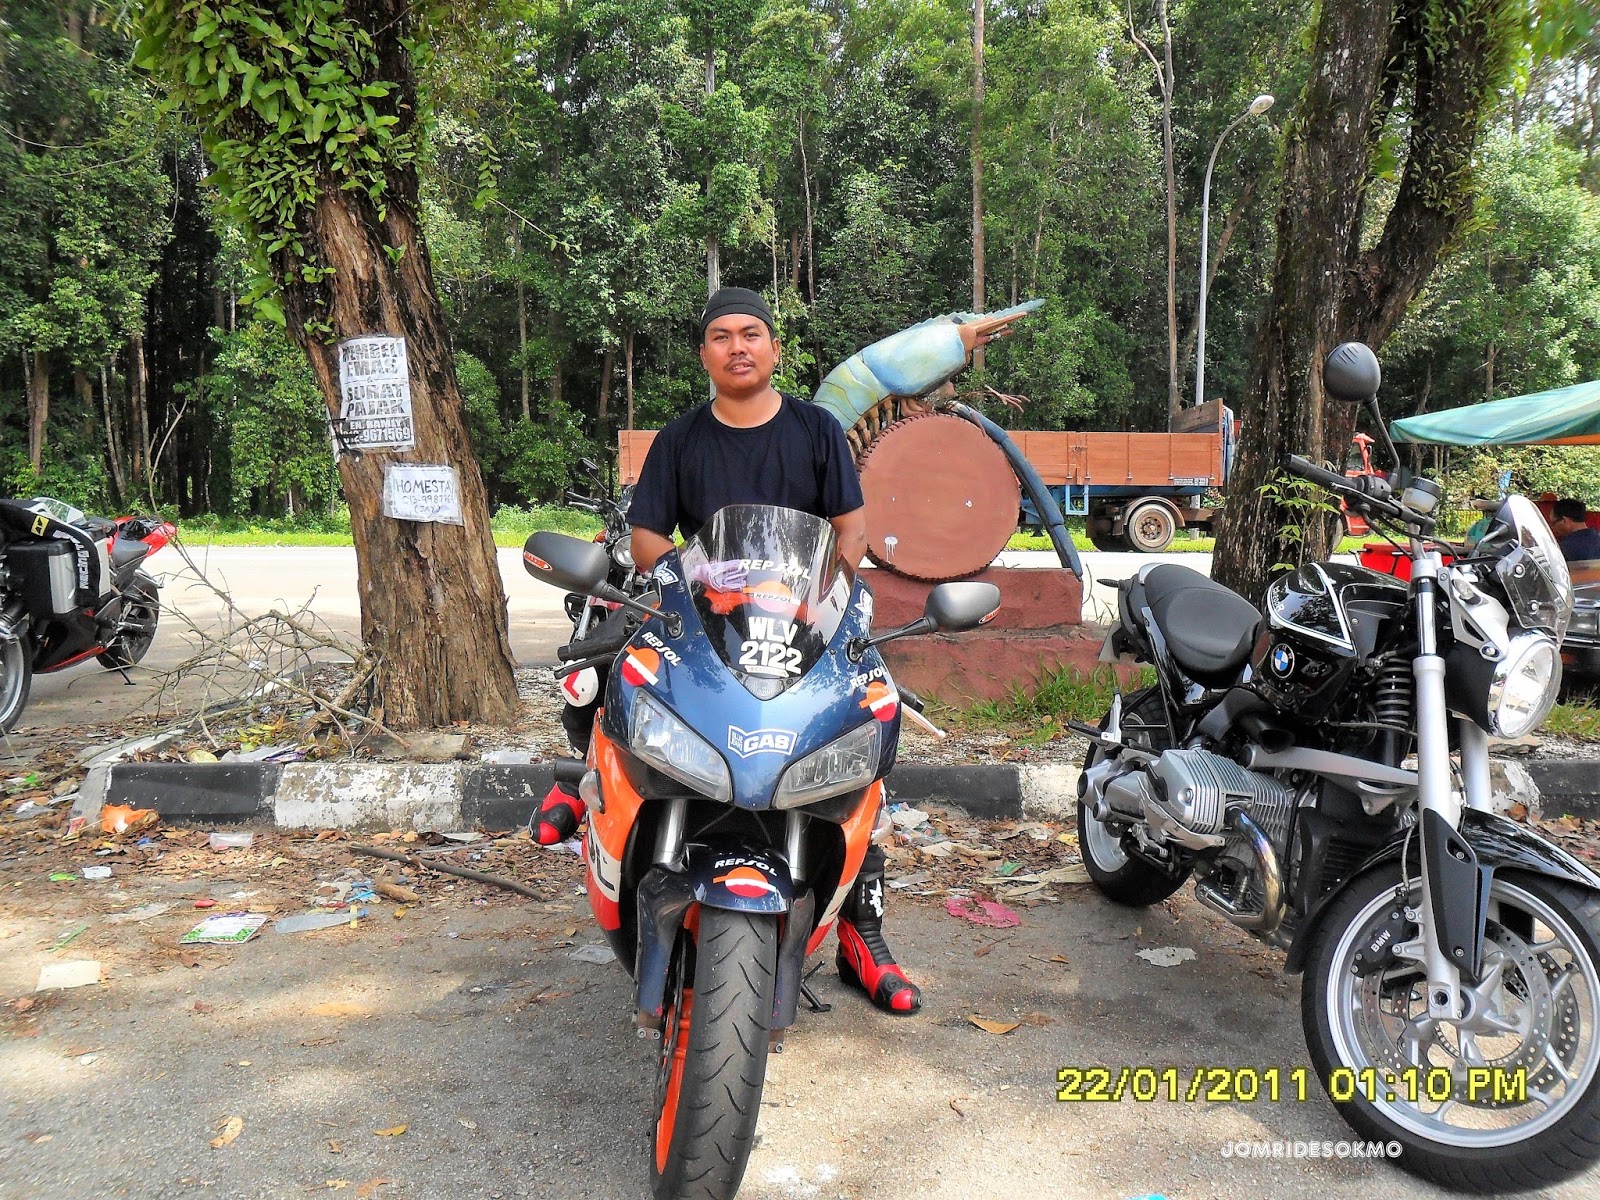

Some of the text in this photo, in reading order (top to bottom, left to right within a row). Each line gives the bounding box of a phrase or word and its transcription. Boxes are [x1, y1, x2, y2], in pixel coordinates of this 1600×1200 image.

[347, 359, 398, 376] EMAS
[346, 384, 405, 401] SURAT
[346, 399, 405, 417] PAJAK
[738, 559, 812, 580] REPSOL
[748, 616, 799, 646] WLV
[641, 631, 682, 667] REPSOL
[739, 640, 803, 675] 2122
[850, 666, 888, 690] REPSOL
[743, 734, 790, 753] GAS
[714, 858, 778, 877] REPSOL
[1370, 930, 1391, 952] BMW
